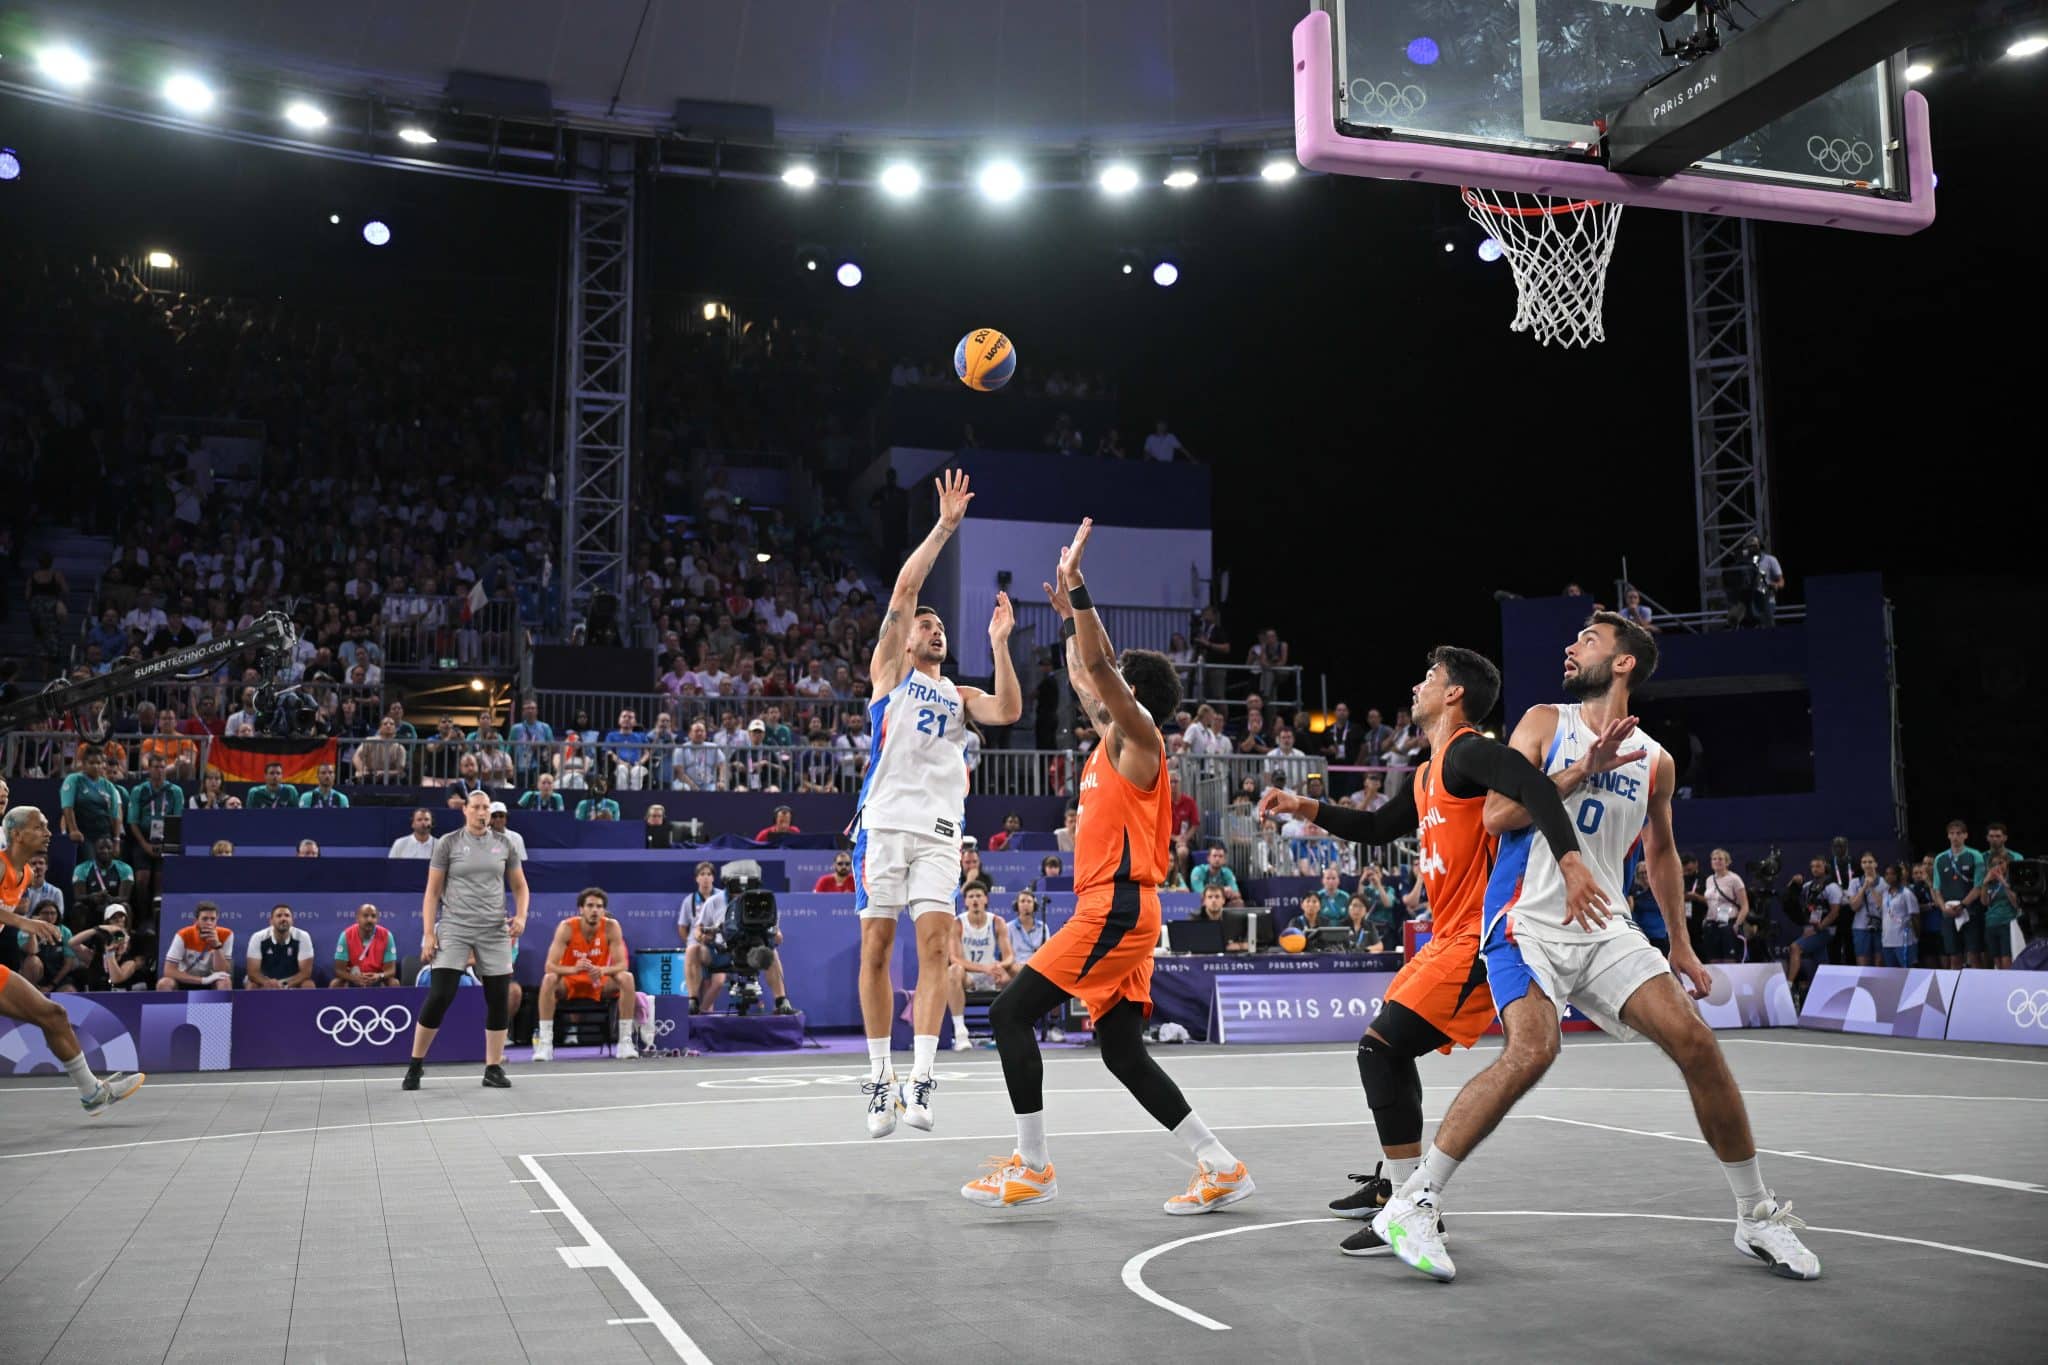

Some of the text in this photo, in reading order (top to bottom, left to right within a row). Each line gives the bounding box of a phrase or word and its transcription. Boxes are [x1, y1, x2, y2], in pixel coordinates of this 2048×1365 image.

[1653, 72, 1717, 120] PARIS 2024
[134, 639, 231, 678] SUPERTECHNO.COM
[917, 708, 948, 738] 21
[1564, 757, 1641, 802] FANCE
[1576, 798, 1604, 835] 0
[1268, 961, 1294, 970] PARIS
[1238, 998, 1383, 1020] PARIS 202
